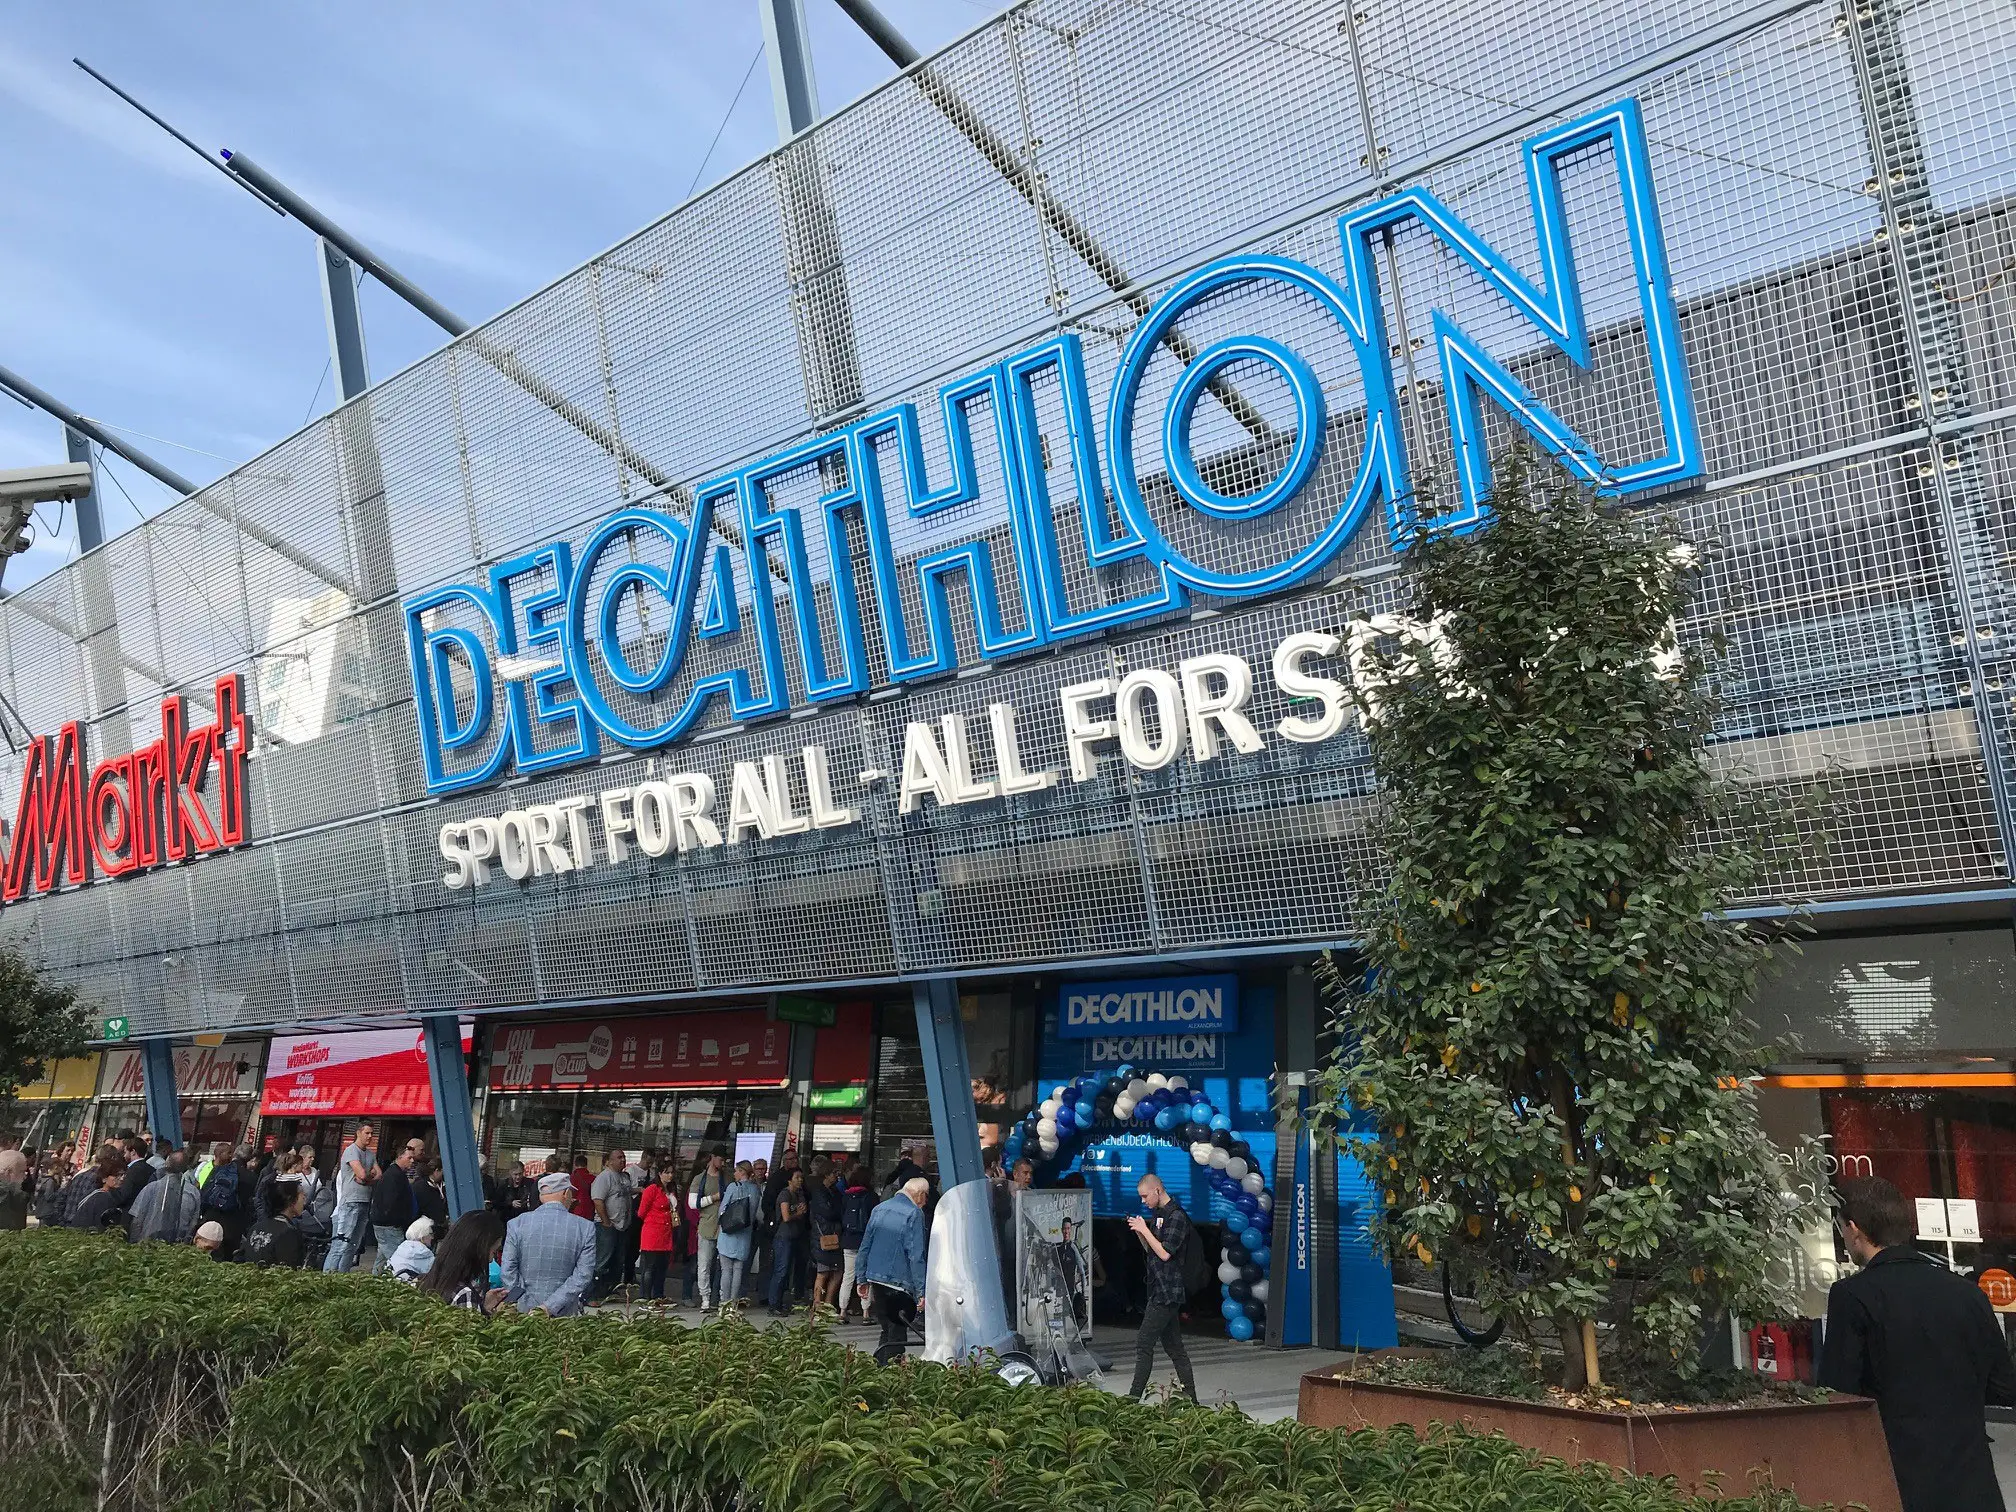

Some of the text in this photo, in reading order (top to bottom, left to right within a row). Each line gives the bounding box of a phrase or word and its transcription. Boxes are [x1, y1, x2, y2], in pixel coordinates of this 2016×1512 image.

[402, 97, 1706, 795] DECATHLON
[439, 796, 594, 889] SPORT
[600, 772, 723, 864] FOR
[728, 746, 861, 845] ALL
[899, 702, 1056, 815] ALL
[1060, 653, 1266, 783] FOR
[3, 673, 253, 901] Markt
[1067, 988, 1222, 1026] DECATHLON
[506, 1029, 536, 1050] JOIN
[1092, 1034, 1216, 1062] DECATHLON
[287, 1047, 329, 1068] WORKSHOPS
[509, 1050, 523, 1065] THE
[567, 1058, 586, 1072] CLUB
[503, 1064, 534, 1086] CLUB
[1297, 1183, 1306, 1270] DECATHLON
